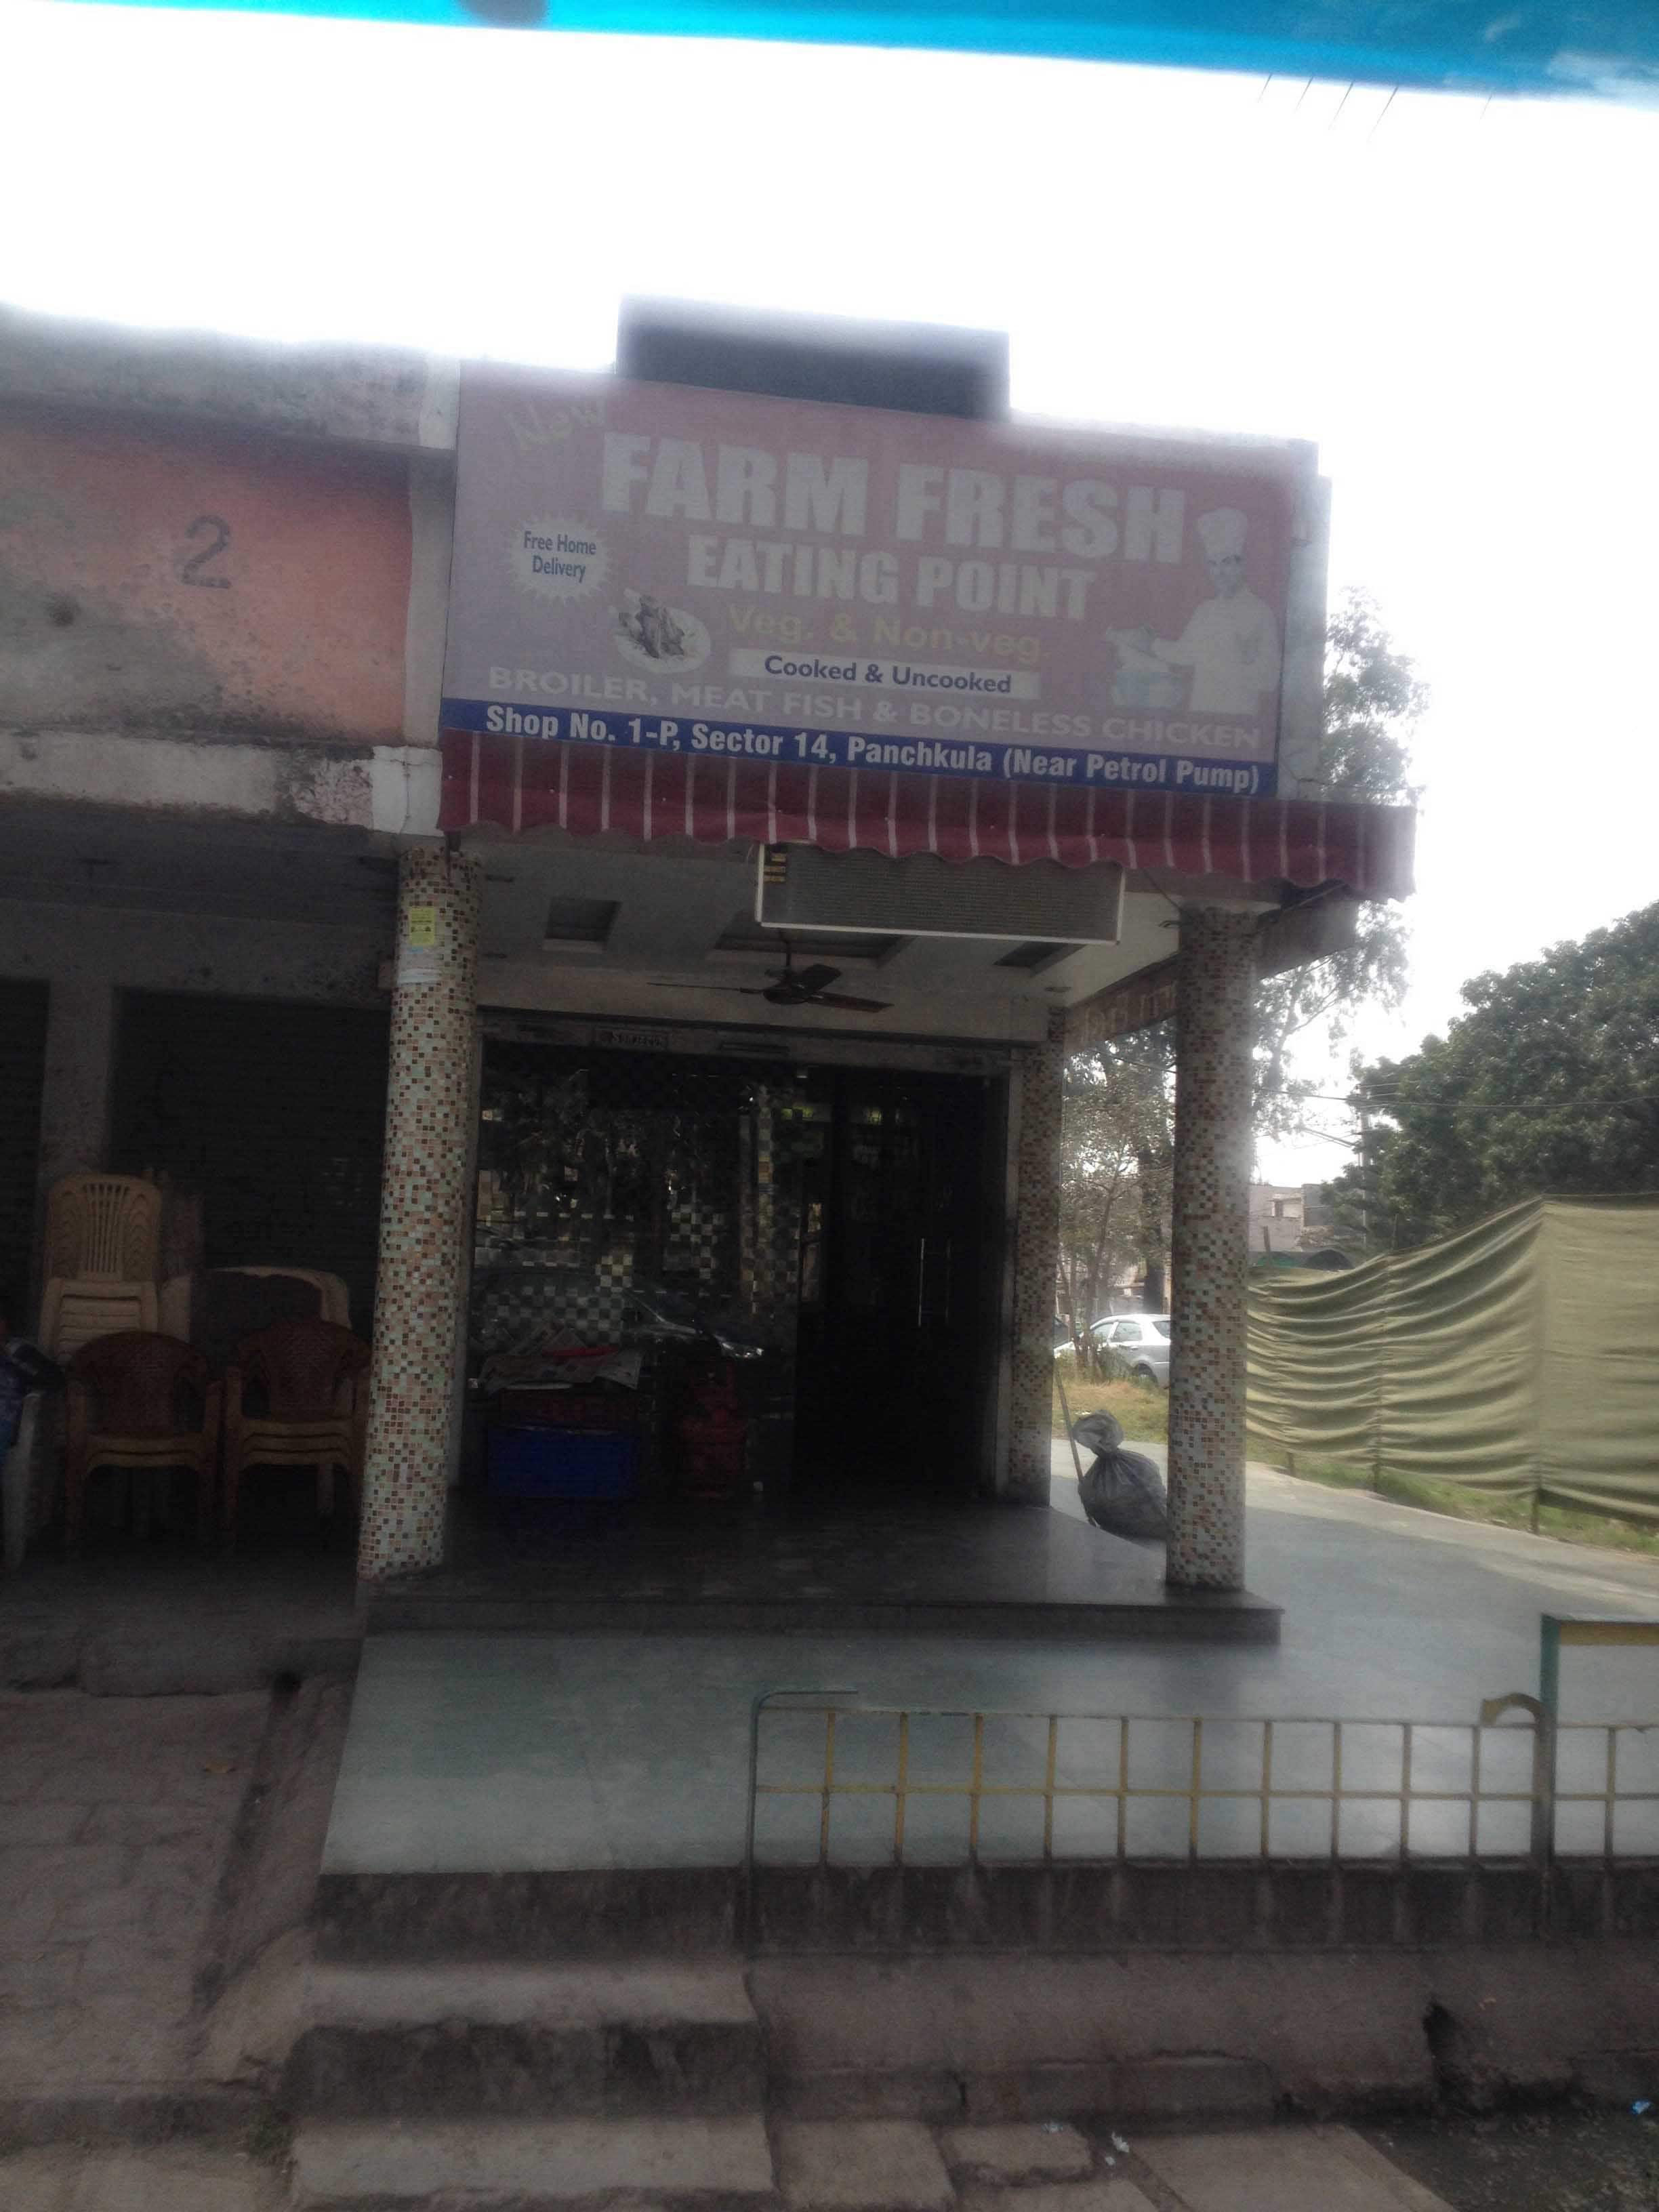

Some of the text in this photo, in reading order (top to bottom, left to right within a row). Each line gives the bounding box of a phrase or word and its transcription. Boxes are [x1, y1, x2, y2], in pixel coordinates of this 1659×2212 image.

[602, 431, 1187, 565] FARM FRESH
[182, 514, 232, 589] 2
[523, 530, 597, 555] Free Home
[532, 554, 587, 584] Delivery
[686, 534, 1097, 619] EATING POINT
[831, 612, 857, 642] &
[488, 665, 1261, 750] BROILER, MEAT FISH & BONELESS CHICKEN
[764, 655, 1012, 693] Cooked & Uncooked
[486, 705, 1261, 796] Shop No. 1-P, Sector 14, Panchkula (Near Petrol Pump)
